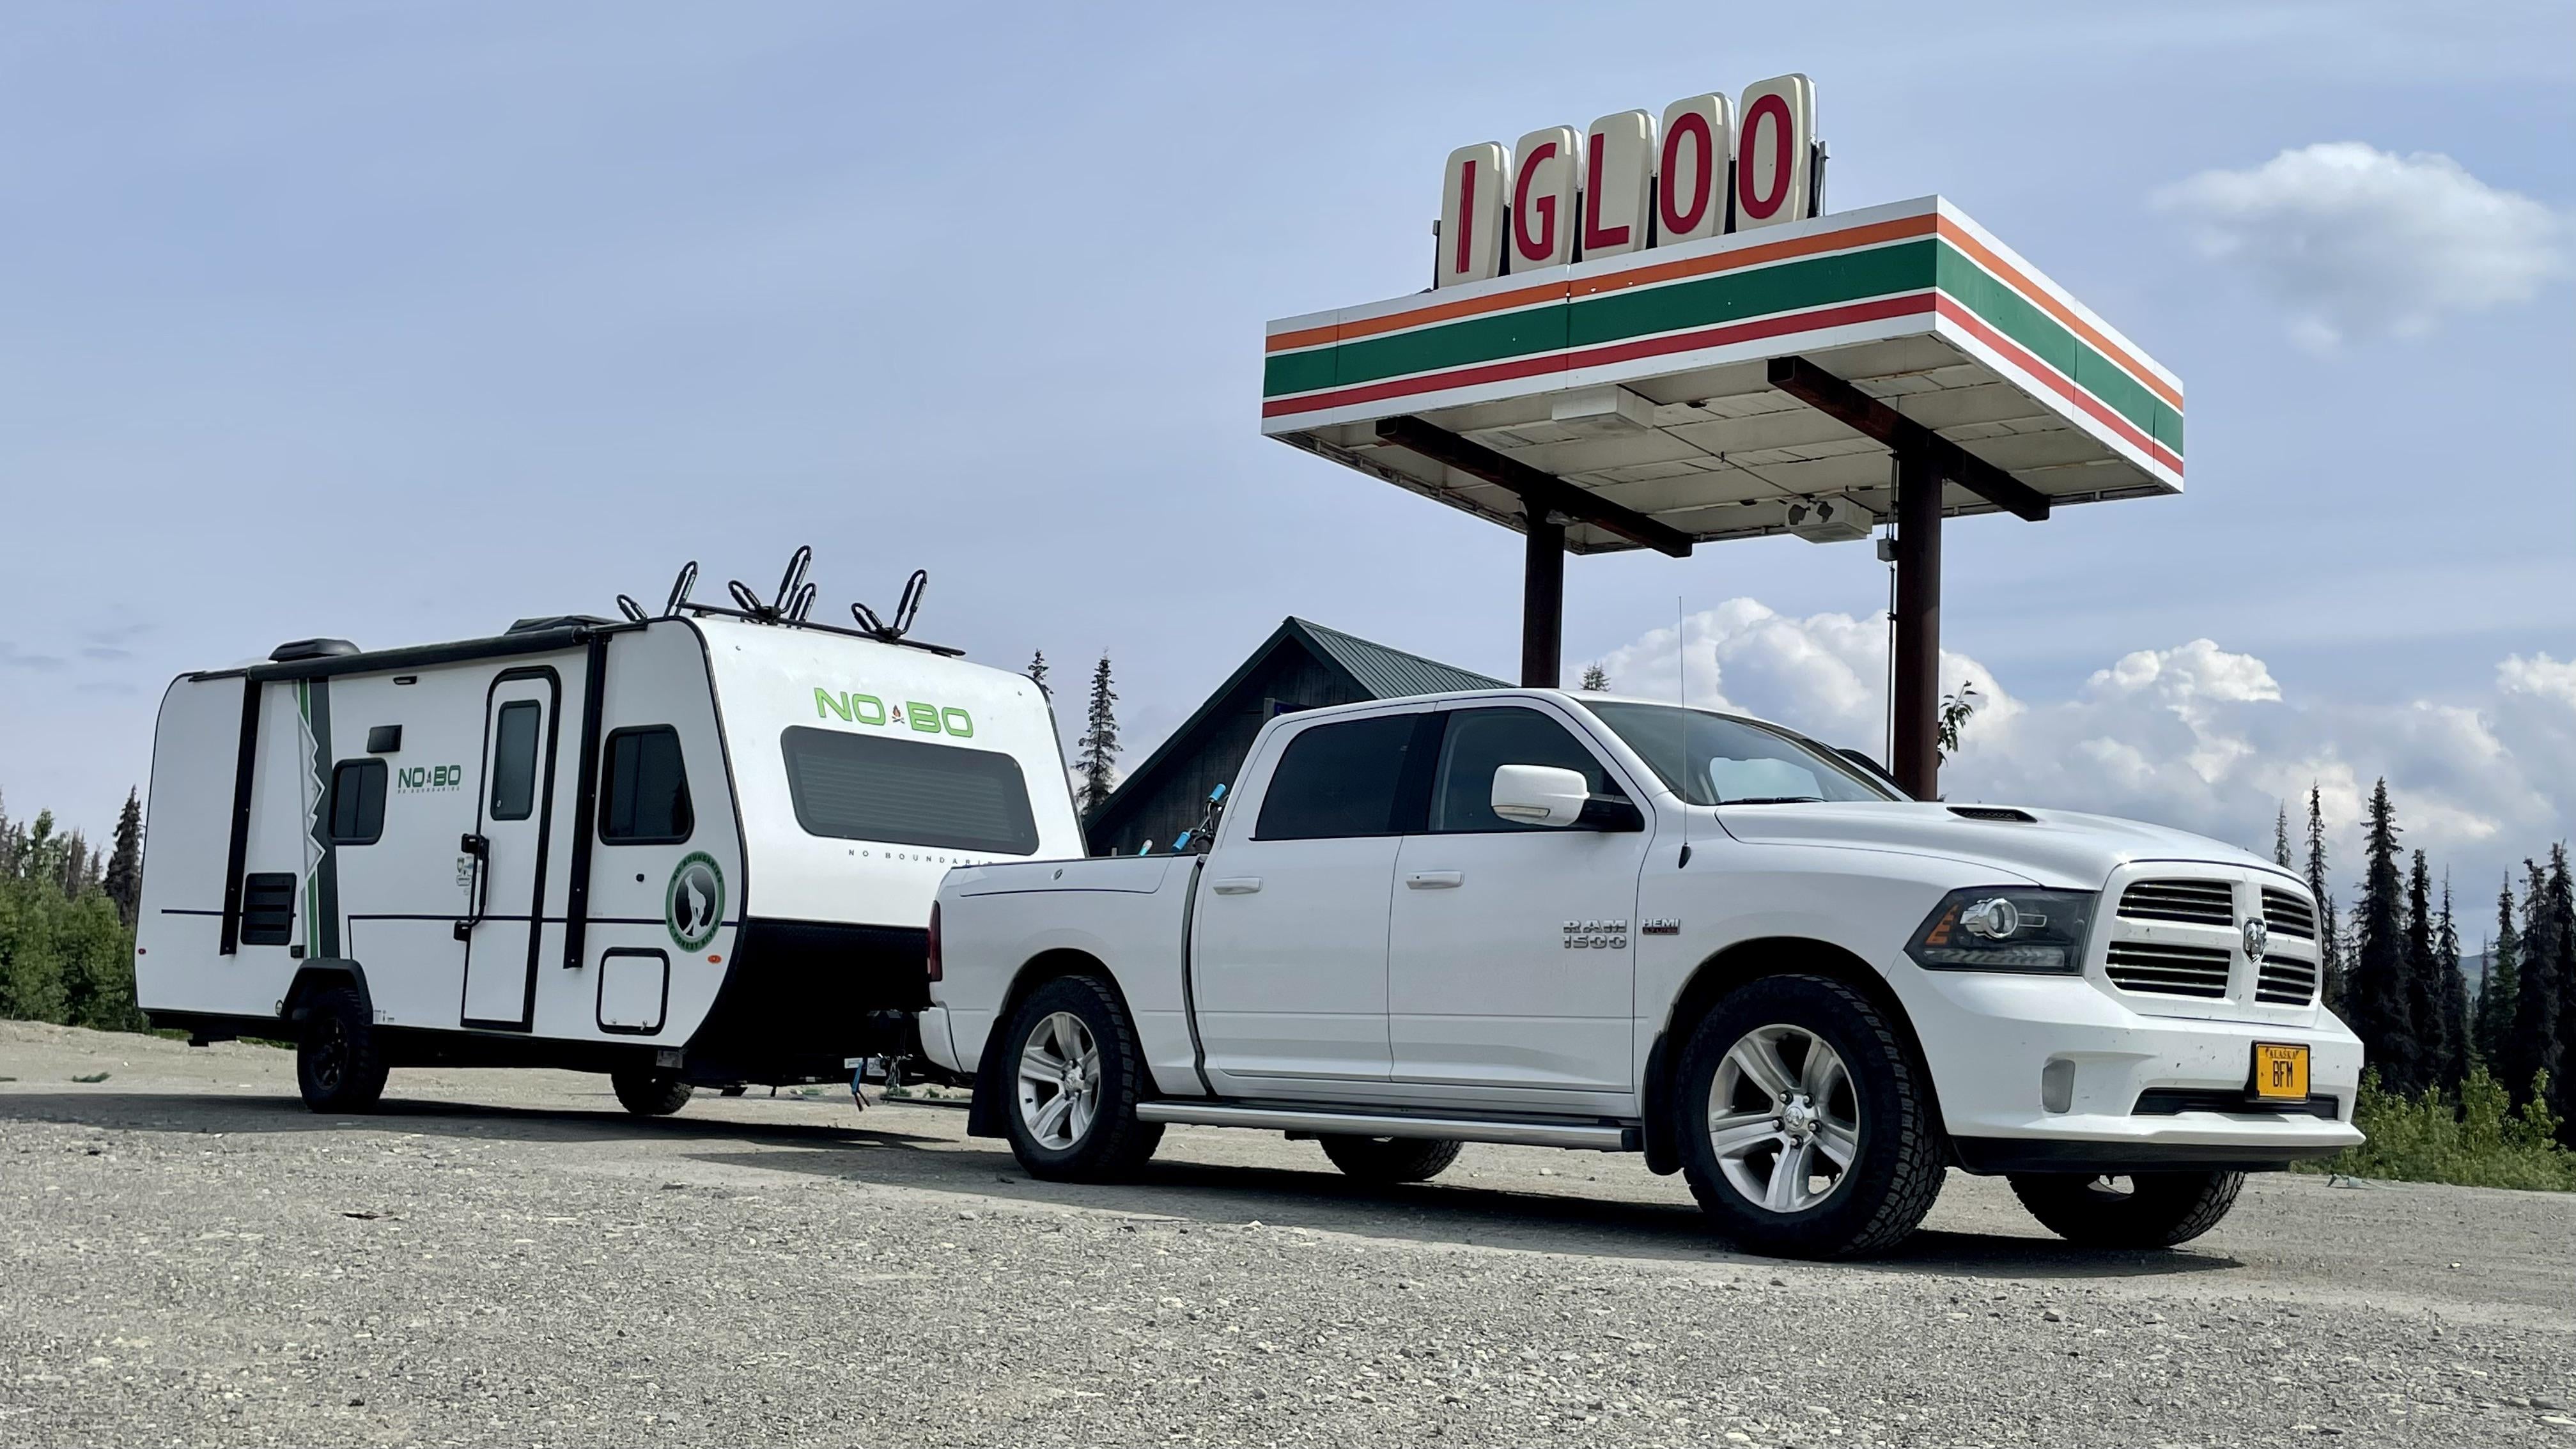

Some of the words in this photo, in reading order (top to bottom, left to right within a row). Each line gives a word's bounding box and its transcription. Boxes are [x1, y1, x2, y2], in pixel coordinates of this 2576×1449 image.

[1456, 94, 1792, 274] IGLOO
[814, 687, 886, 726] NO
[906, 701, 974, 738] BO
[398, 767, 425, 788] NO
[433, 765, 461, 786] BO
[1563, 920, 1627, 933] RAM
[1642, 918, 1680, 927] HEMI
[1563, 934, 1627, 949] 1500
[2270, 1050, 2298, 1059] ALASKA
[2273, 1060, 2293, 1087] BFM
